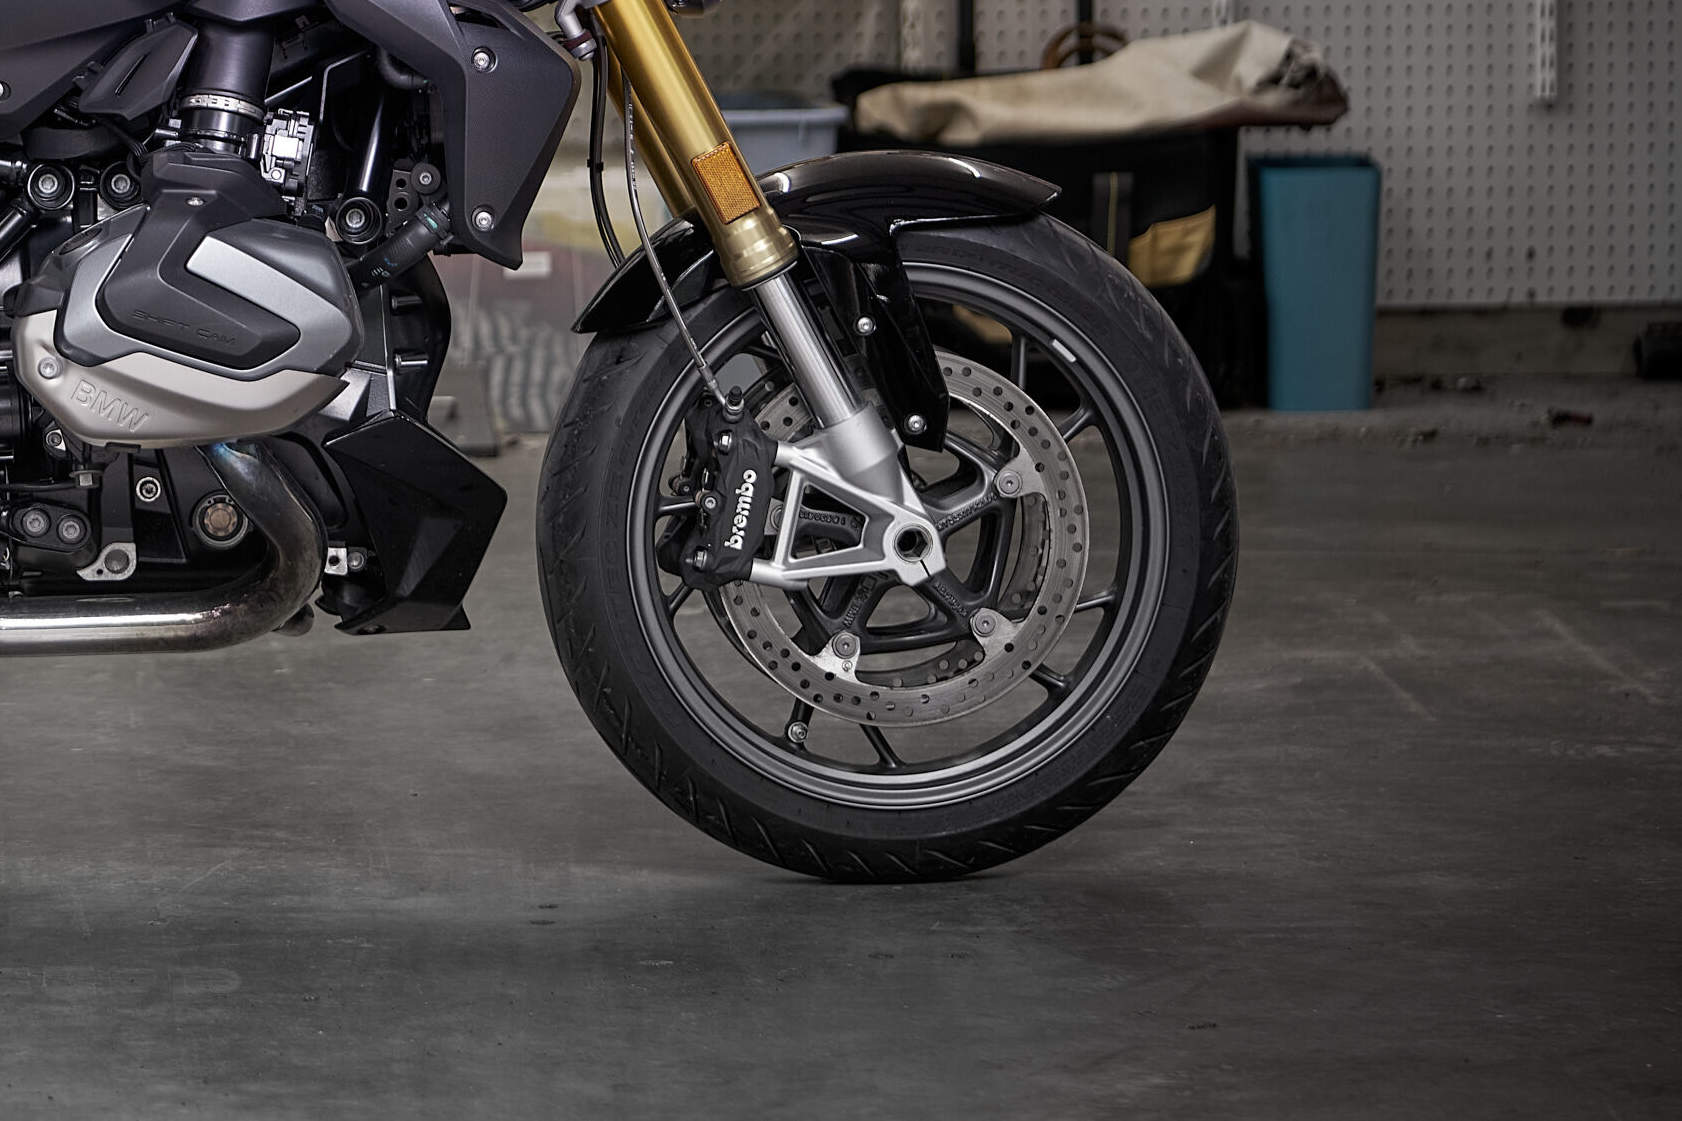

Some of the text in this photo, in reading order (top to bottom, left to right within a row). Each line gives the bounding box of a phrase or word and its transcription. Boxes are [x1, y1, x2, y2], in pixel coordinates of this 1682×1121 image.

[132, 309, 236, 346] SHIFT CAM
[69, 378, 151, 434] BMW
[723, 468, 758, 551] brembo
